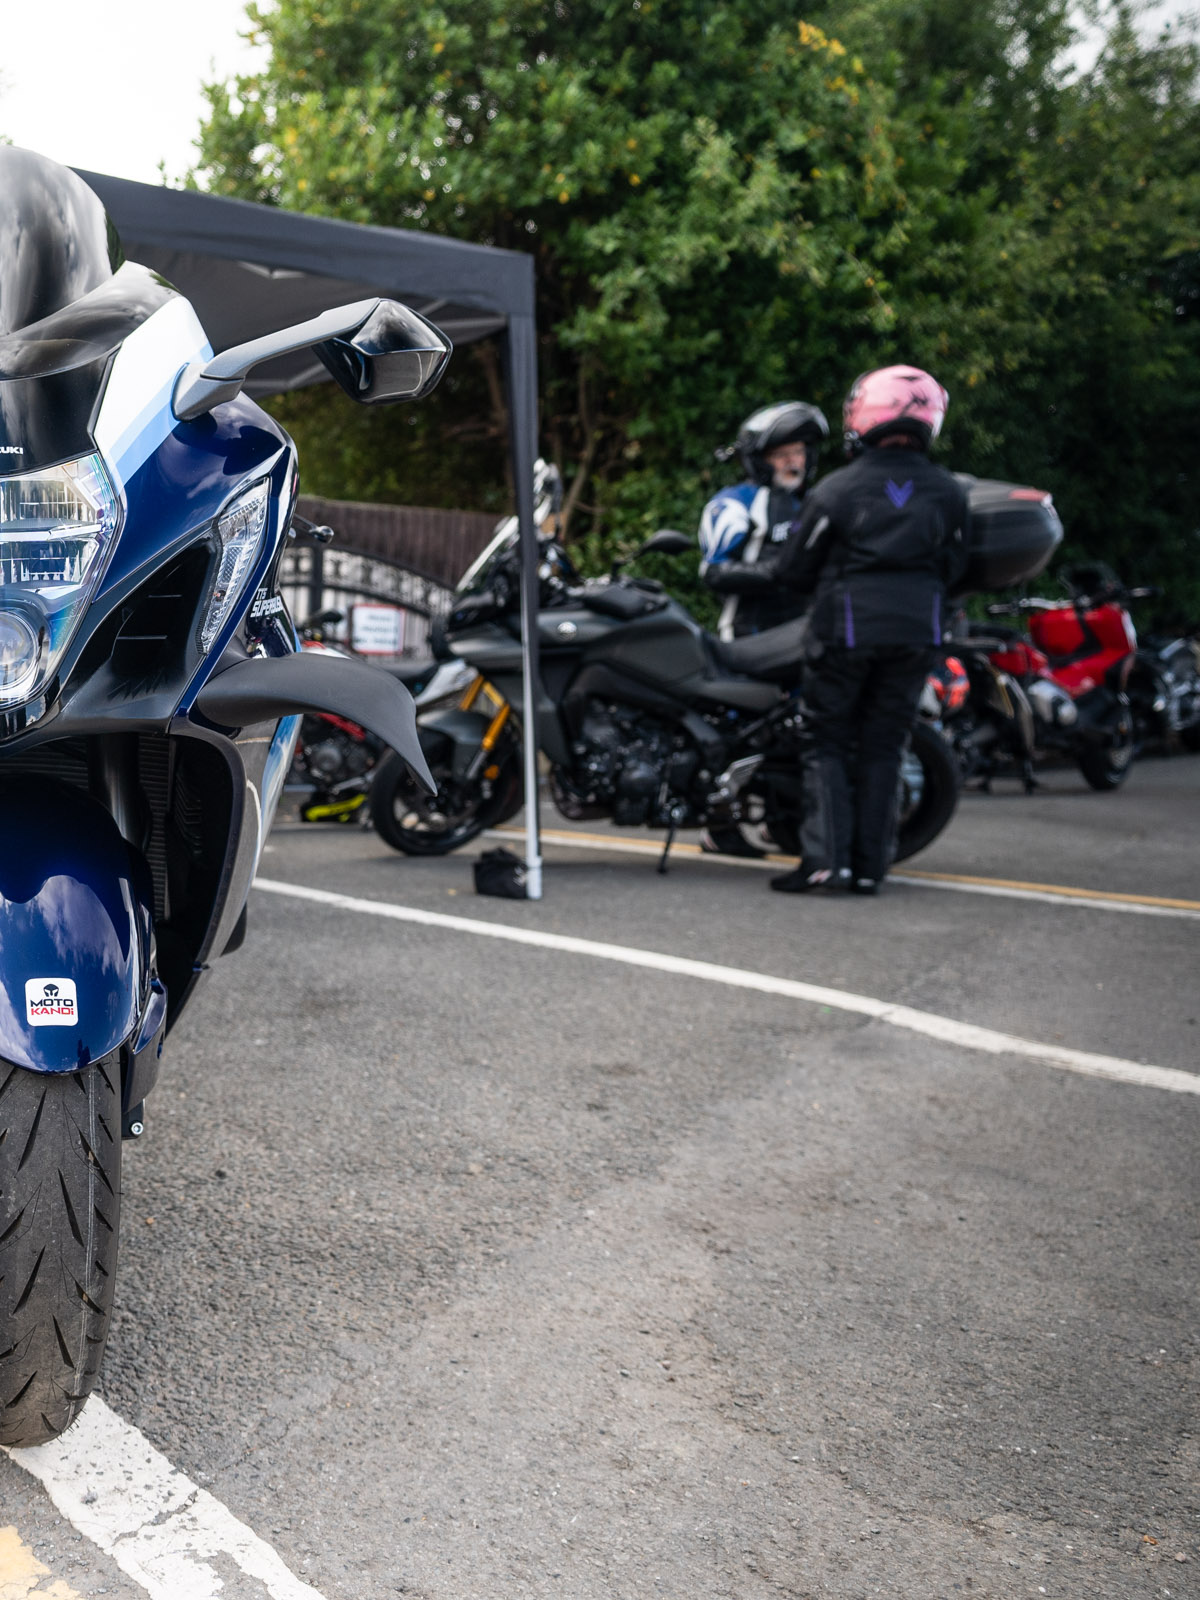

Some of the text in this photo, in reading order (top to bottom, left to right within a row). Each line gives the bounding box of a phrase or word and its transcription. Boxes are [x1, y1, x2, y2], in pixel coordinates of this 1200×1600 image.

[256, 588, 268, 600] TTS
[250, 595, 284, 618] SUPERBUS
[30, 999, 73, 1007] MOTO
[31, 1007, 74, 1015] KANDi
